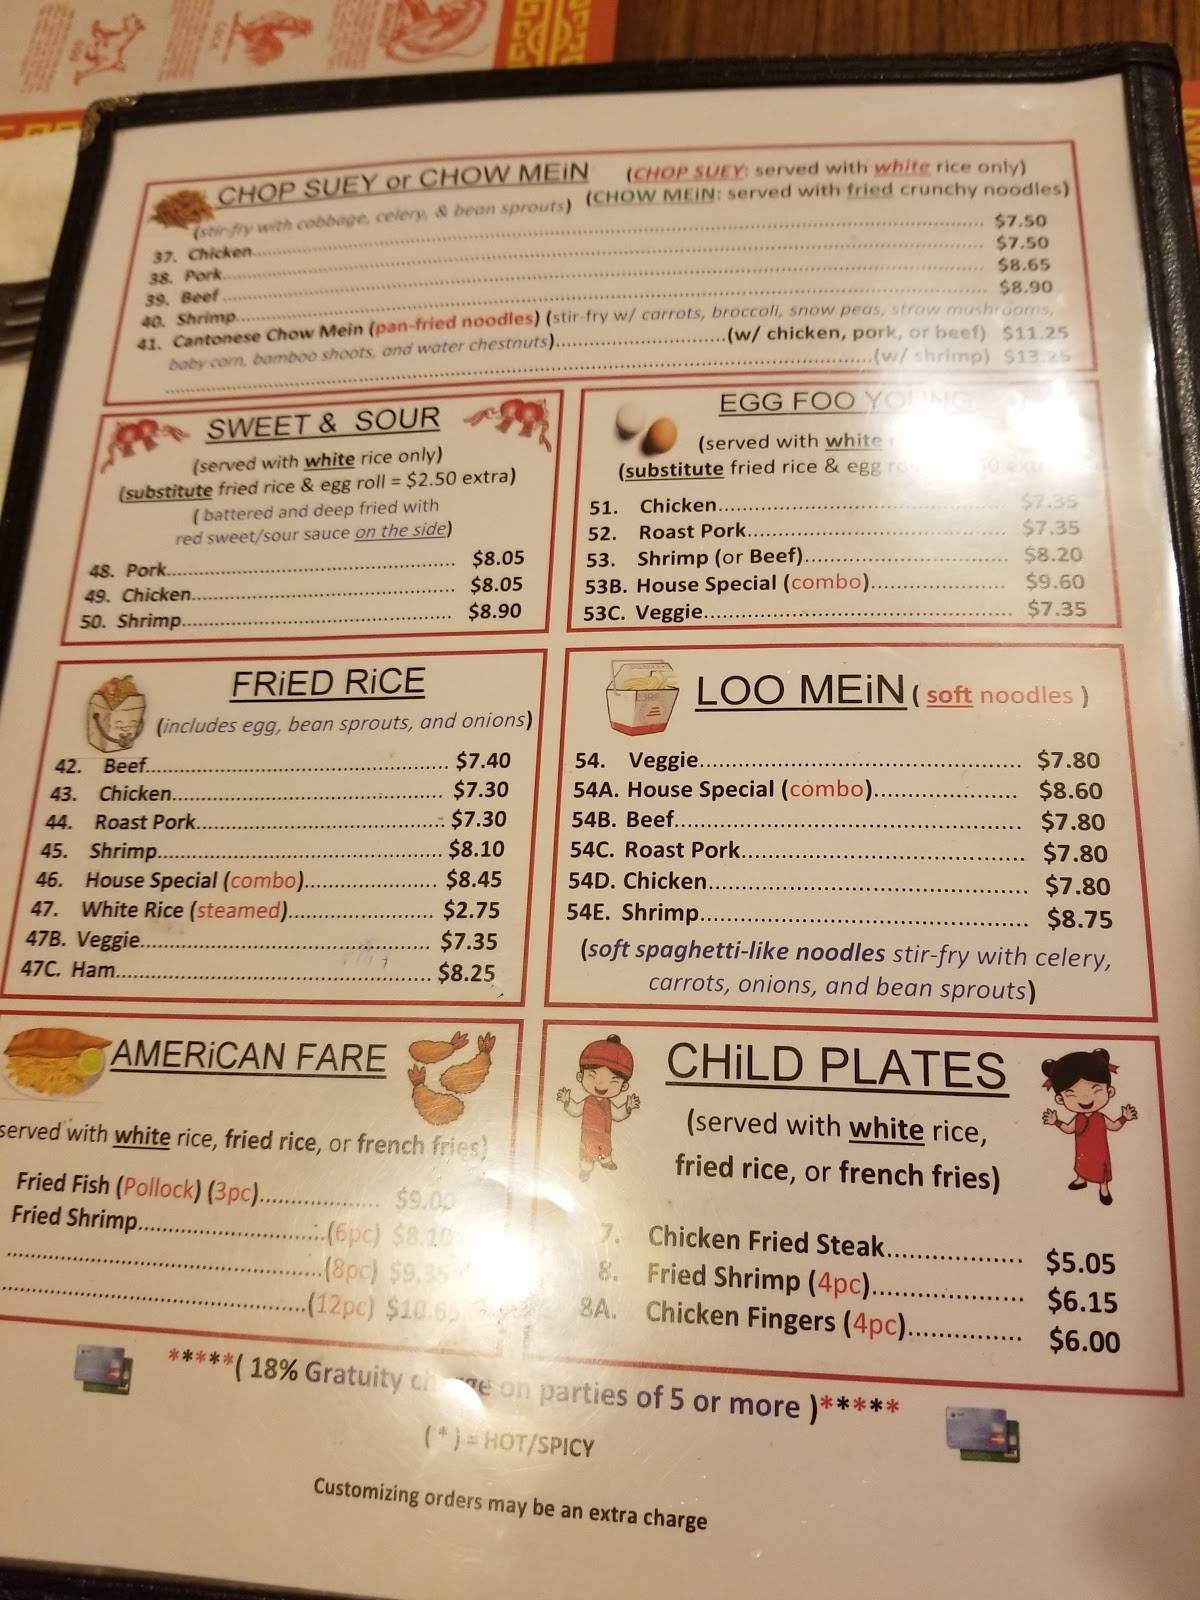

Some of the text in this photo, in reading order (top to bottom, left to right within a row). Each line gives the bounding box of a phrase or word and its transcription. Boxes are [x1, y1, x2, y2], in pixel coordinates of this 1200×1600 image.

[756, 158, 1026, 176] served with white rice only)
[218, 164, 510, 206] CHOP SUEY CHOW
[728, 181, 1070, 200] served with fried crunchy noodles)
[995, 214, 1048, 229] $7.50
[996, 235, 1049, 251] $7.50
[173, 310, 540, 349] Cantonese Chow Mein (pan-fried noodles)
[767, 326, 847, 342] chicken,
[721, 393, 783, 412] EGG
[794, 391, 855, 411] FOO
[207, 407, 440, 441] SWEET & SOUR
[699, 434, 818, 453] (served with
[193, 446, 443, 475] (served with white rice only)
[619, 458, 839, 482] (substitute fried rice &
[119, 467, 517, 503] (substitute fried rice egg roll $2.50 extra)
[207, 519, 452, 544] sweet/sour on the side)
[640, 524, 694, 539] Roast
[473, 549, 525, 568] $8.05
[637, 548, 743, 568] Shrimp (or
[470, 576, 523, 594] $8.05
[637, 575, 776, 594] House Special
[1026, 574, 1085, 591] $9.60
[469, 602, 522, 621] $8.90
[1028, 601, 1087, 619] $7.35
[698, 675, 1073, 708] LOO soft noodles
[157, 710, 533, 737] (includes egg, bean sprouts, and onions)
[456, 751, 511, 772] $7.40
[1037, 750, 1100, 772] $7.80
[454, 780, 509, 800] $7.30
[628, 779, 774, 802] House Special
[1039, 780, 1102, 802] $8.60
[95, 814, 147, 829] Roast
[451, 809, 507, 830] $7.30
[1041, 811, 1106, 834] $7.80
[448, 839, 505, 860] $8.10
[625, 841, 684, 859] Roast
[1043, 842, 1108, 865] $7.80
[86, 871, 217, 892] House Special
[446, 869, 502, 891] $8.45
[1045, 874, 1111, 897] $7.80
[82, 901, 184, 919] White Rice
[443, 900, 500, 922] $2.75
[1047, 907, 1113, 930] $8.75
[440, 931, 498, 953] $7.35
[581, 938, 1111, 972] (soft spaghetti-like noodles stir-fry with celery,
[438, 963, 495, 984] $8.25
[649, 974, 1036, 1006] carrots, onions, and bean sprouts)
[297, 1042, 387, 1072] FARE
[821, 1047, 1007, 1090] PLATES
[687, 1108, 987, 1147] (served with white rice,
[67, 1124, 425, 1155] with white rice, fried rice, or french
[676, 1153, 1001, 1195] fried rice, or french fries)
[16, 1172, 201, 1204] Fried Fish (Pollock)
[12, 1204, 62, 1226] Fried
[649, 1225, 809, 1254] Chicken Fried
[1046, 1248, 1116, 1275] $5.05
[647, 1262, 800, 1292] Fried Shrimp
[1048, 1287, 1118, 1314] $6.15
[646, 1300, 835, 1335] Chicken Fingers
[1050, 1326, 1121, 1354] $6.00
[251, 1356, 298, 1382] 18%
[305, 1361, 403, 1395] Gratuity
[540, 1379, 628, 1409] parties
[636, 1385, 664, 1410] of
[670, 1387, 684, 1410] 5
[694, 1393, 720, 1413] or
[729, 1394, 800, 1419] more
[314, 1477, 708, 1533] Customizing orders may be an extra charge
